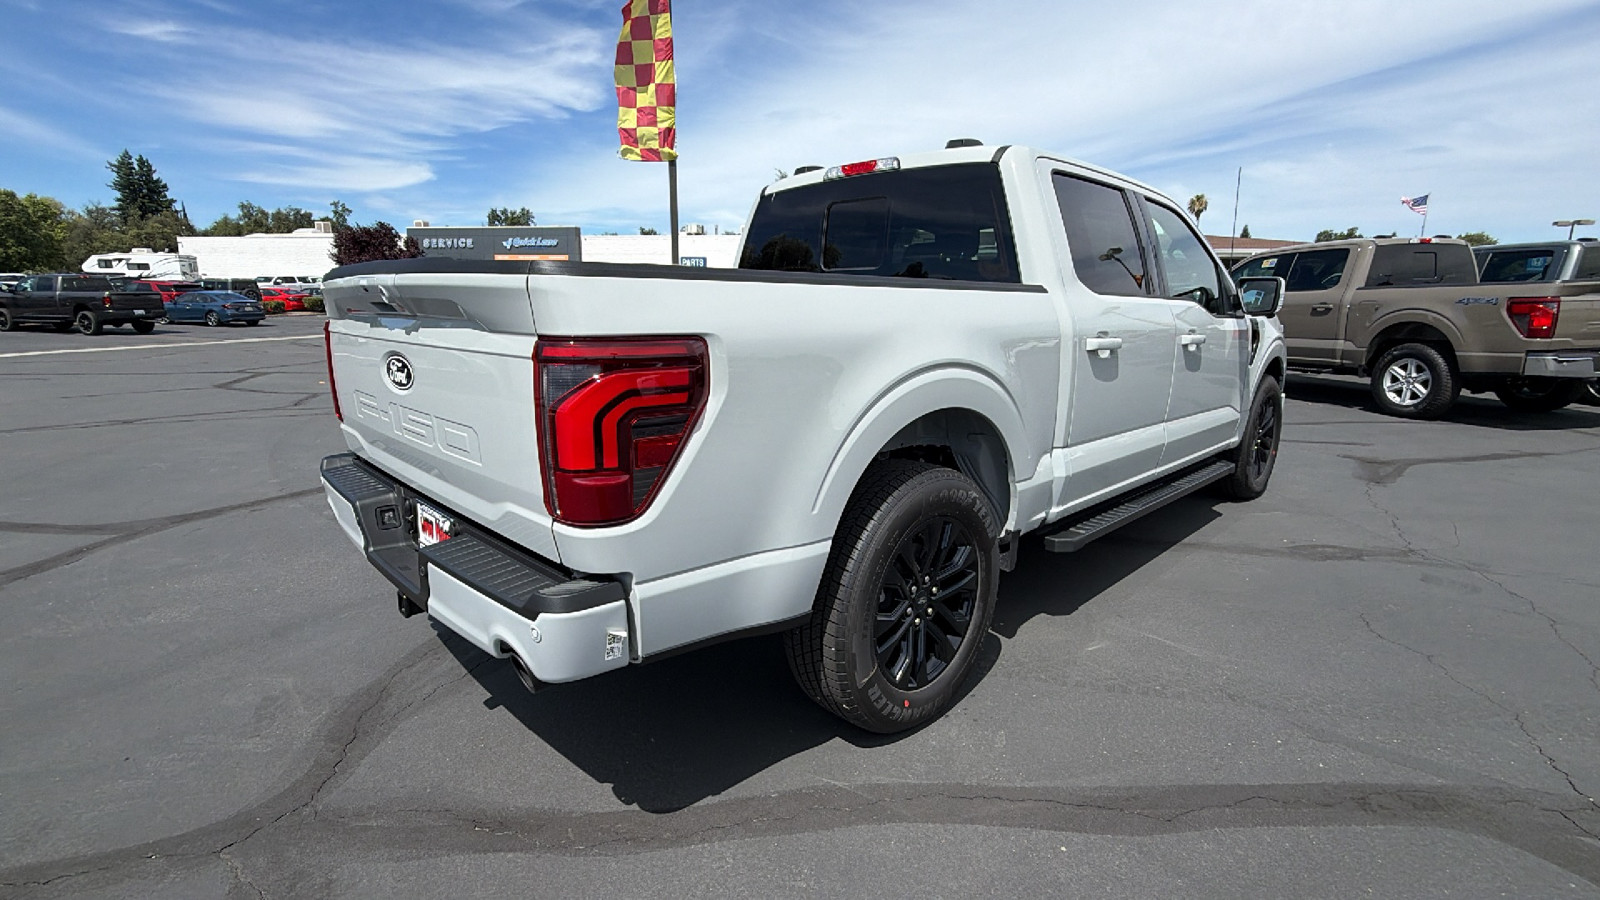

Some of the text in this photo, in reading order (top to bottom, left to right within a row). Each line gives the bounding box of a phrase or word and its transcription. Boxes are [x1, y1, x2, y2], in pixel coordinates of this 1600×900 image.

[422, 237, 474, 249] SERVICE
[682, 258, 704, 268] PARTS
[388, 359, 408, 384] Ford
[353, 389, 483, 467] F-150
